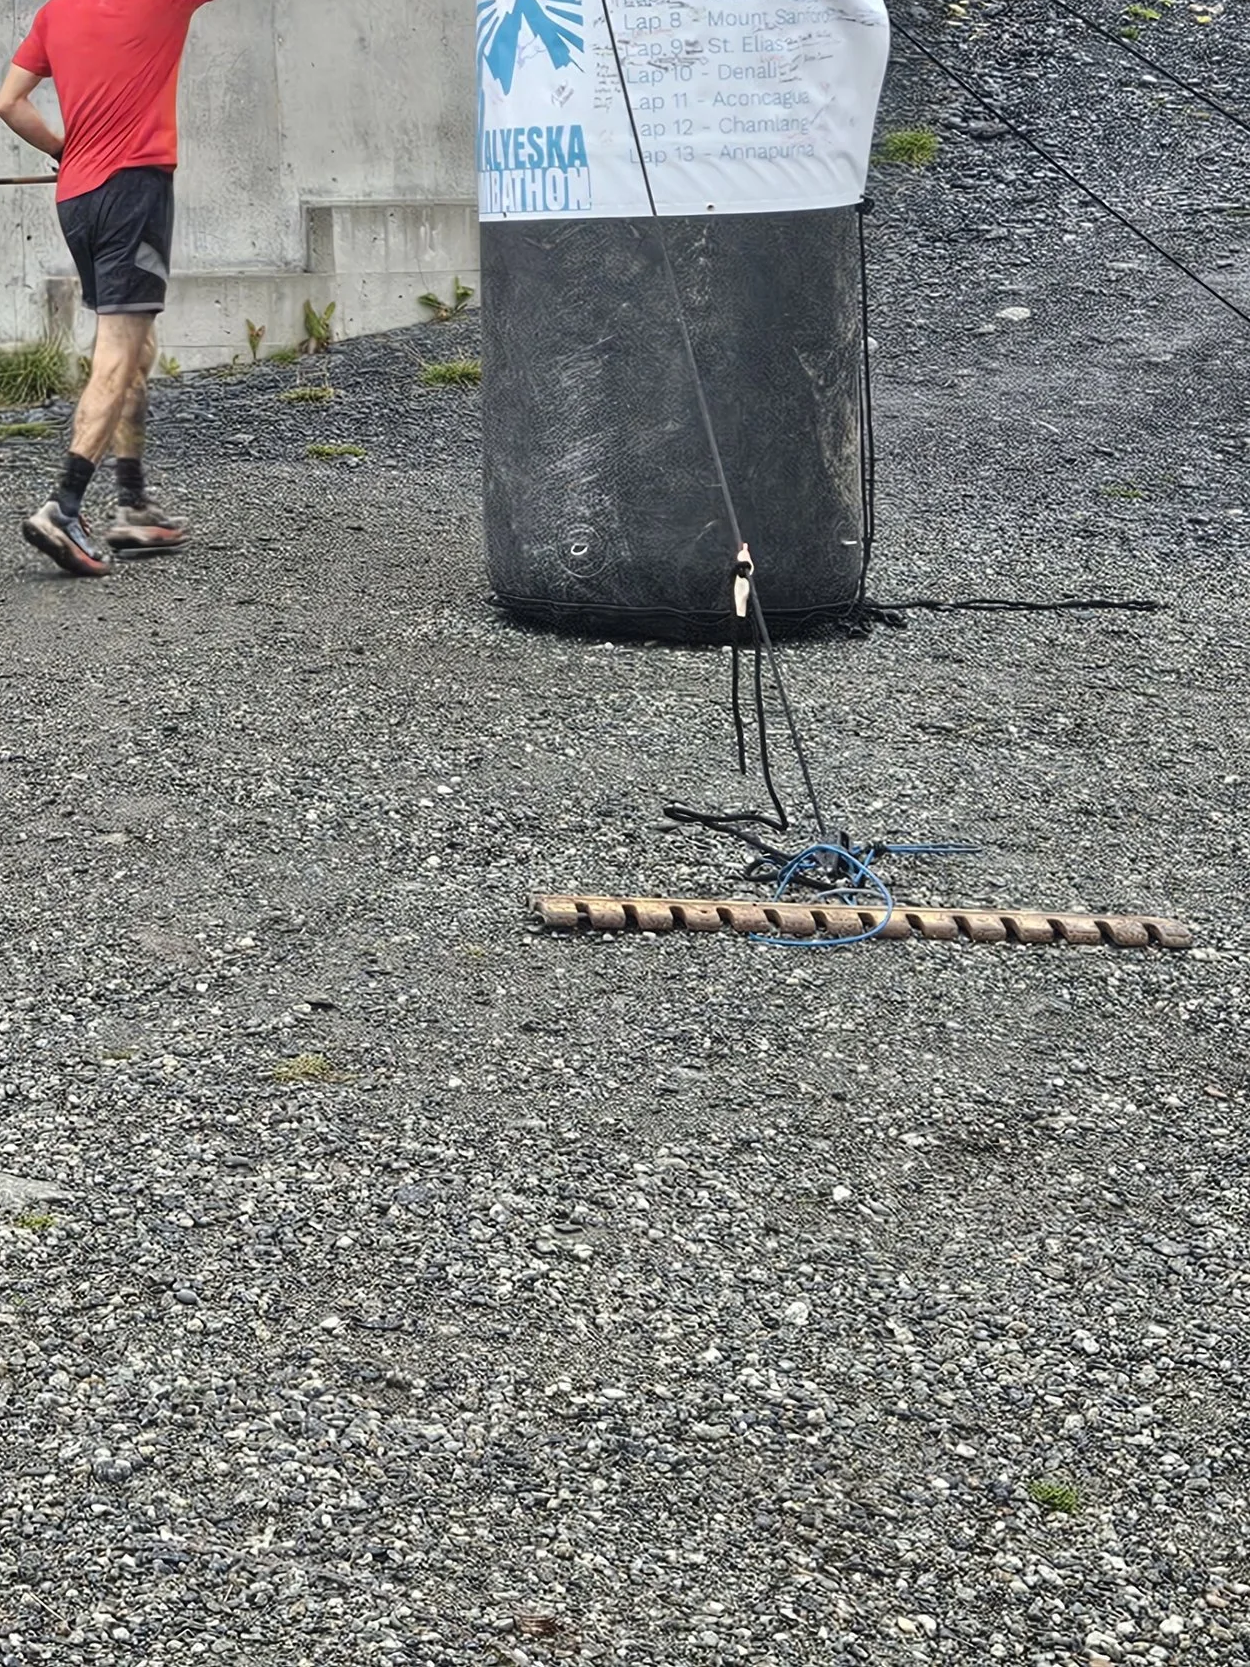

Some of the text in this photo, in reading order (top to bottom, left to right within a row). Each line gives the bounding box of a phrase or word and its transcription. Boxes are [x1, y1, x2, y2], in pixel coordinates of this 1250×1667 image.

[624, 13, 662, 34] Lap
[670, 11, 682, 29] 8
[708, 9, 768, 27] Mount
[626, 40, 662, 59] Lap
[670, 38, 683, 55] 9
[708, 37, 734, 54] St.
[742, 35, 784, 53] Elias
[627, 67, 664, 87] Lap
[672, 64, 693, 82] 10
[718, 60, 777, 80] Denali
[672, 92, 688, 109] 11
[712, 90, 811, 109] Aconcagua
[673, 118, 693, 136] 12
[718, 114, 810, 135] Chamlang
[484, 124, 589, 172] ALYESKA
[674, 145, 695, 163] 13
[718, 143, 815, 161] Annapurna
